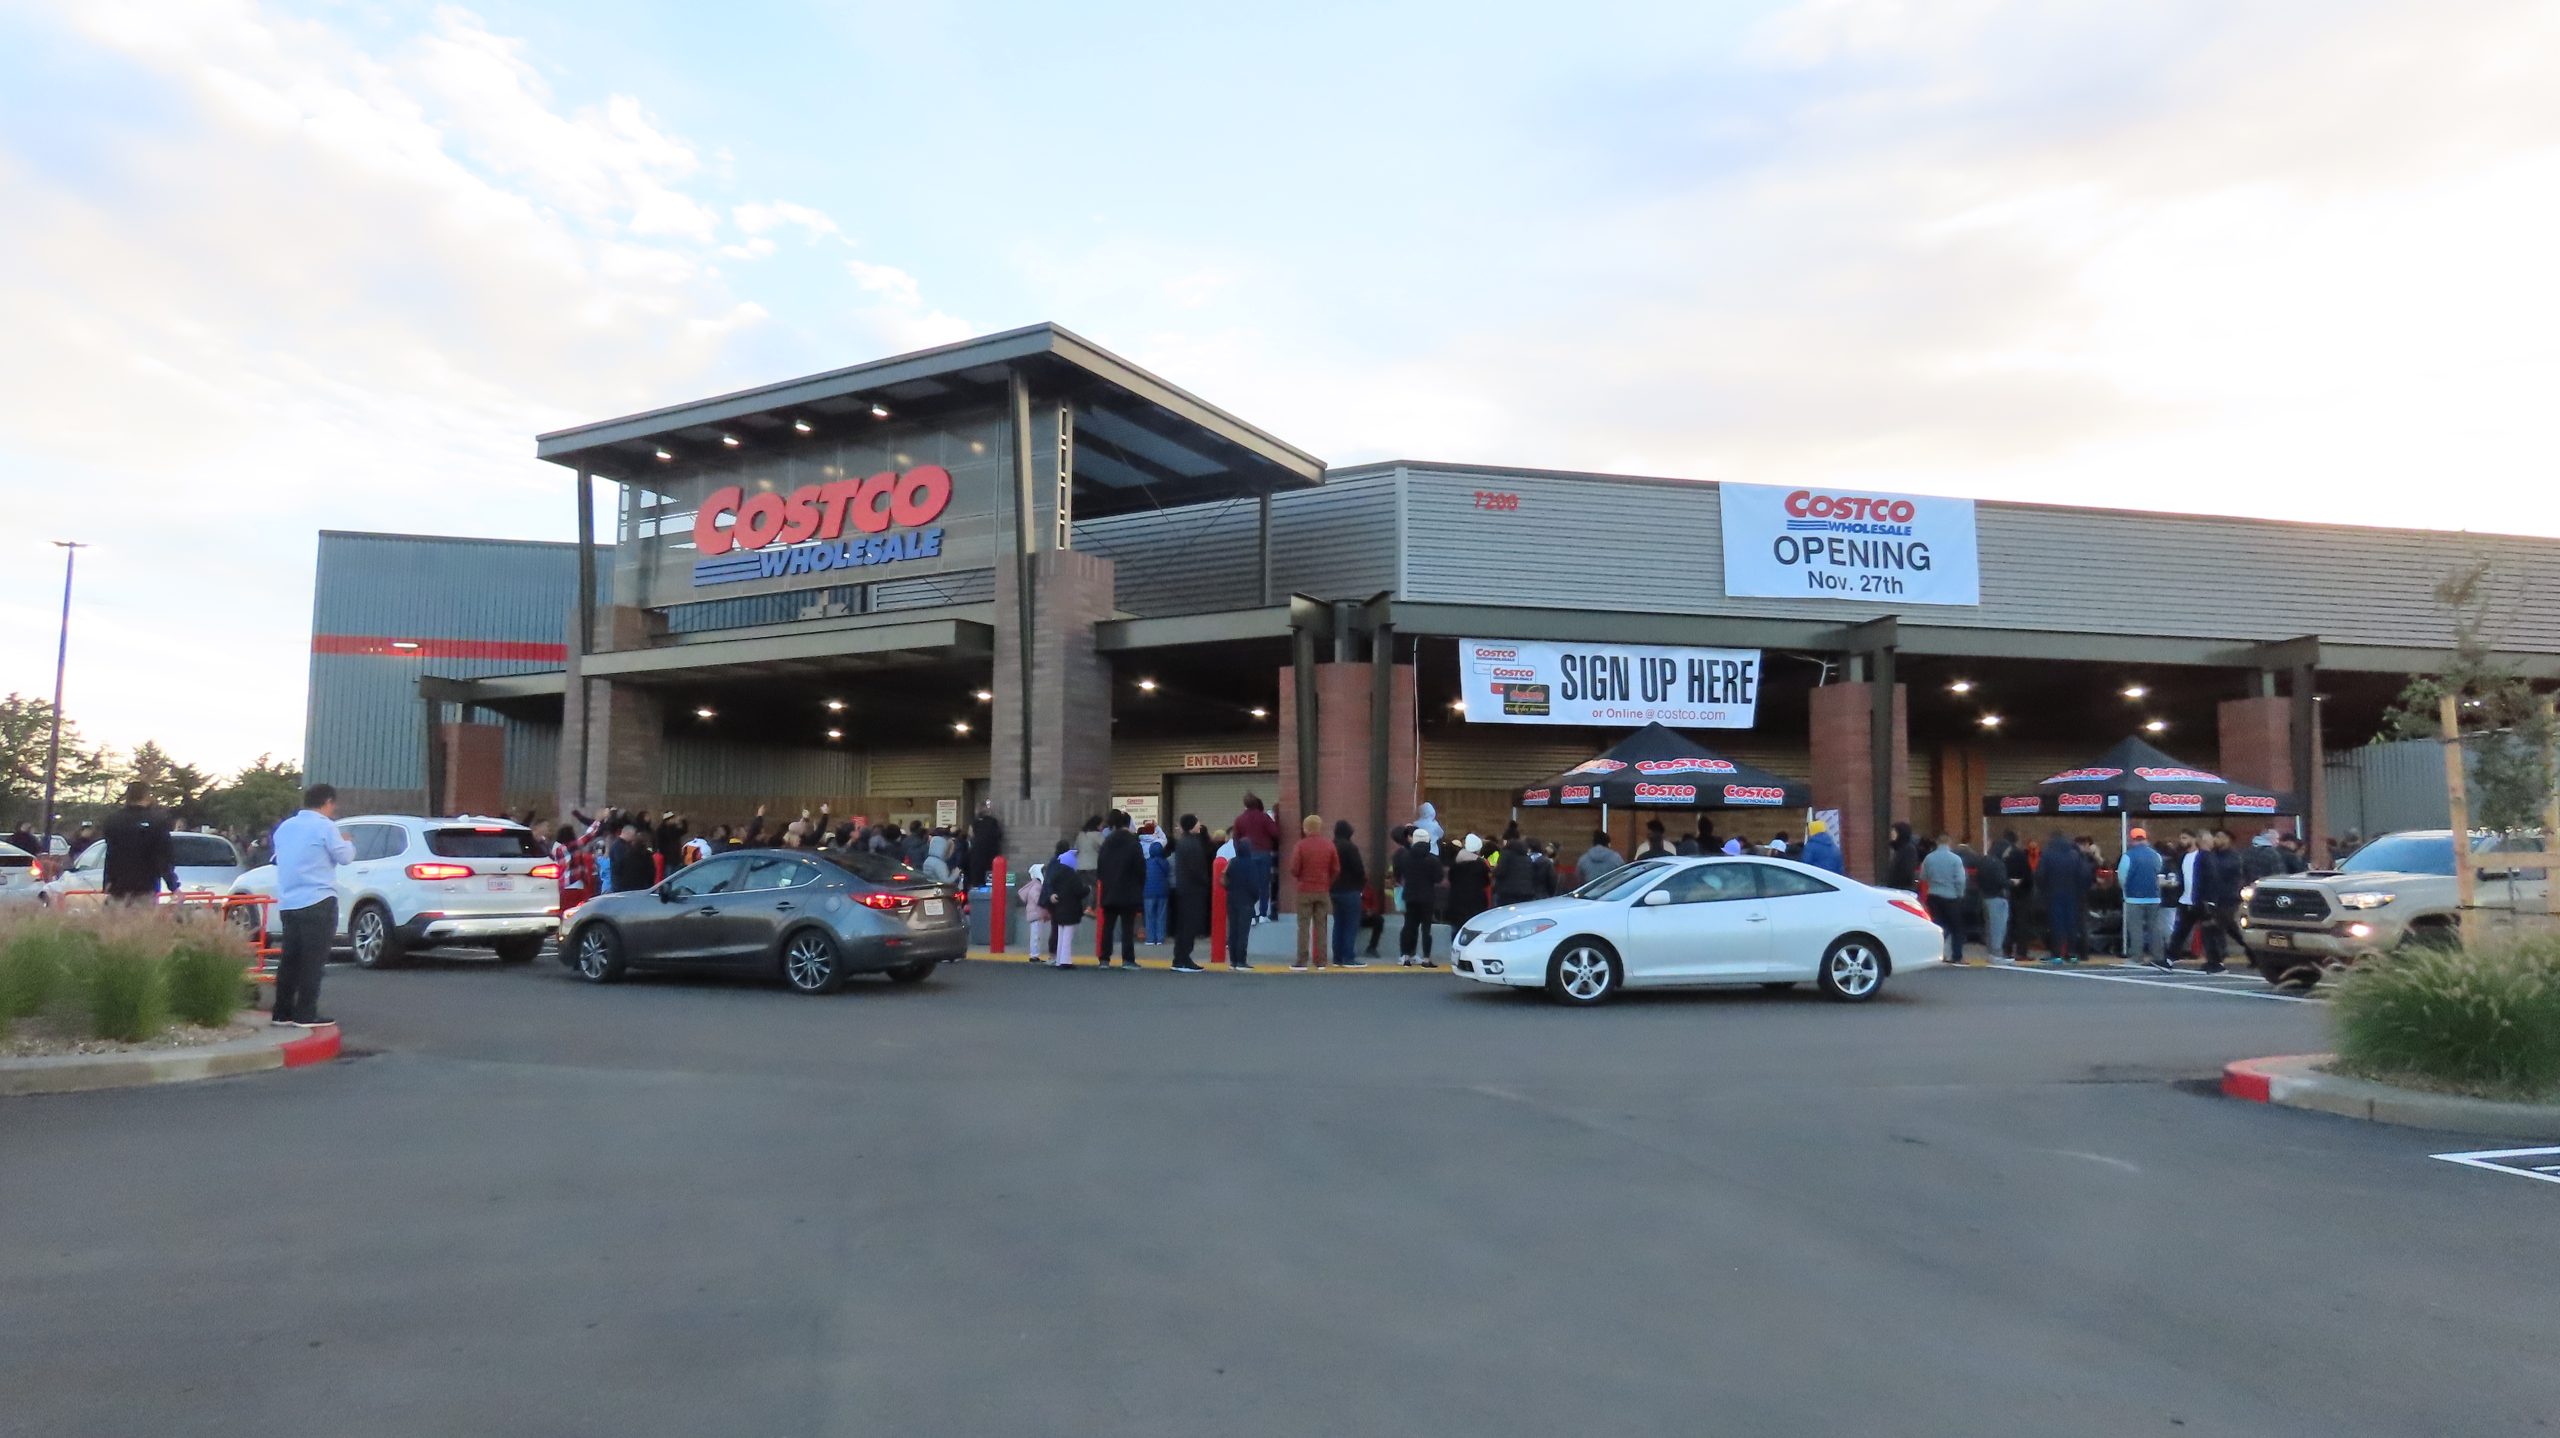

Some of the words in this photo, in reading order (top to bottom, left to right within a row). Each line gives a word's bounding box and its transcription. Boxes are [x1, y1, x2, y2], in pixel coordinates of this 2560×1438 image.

[693, 464, 953, 555] COSTCO
[1785, 490, 1915, 523] COSTCO
[1828, 521, 1912, 536] WHOLESALE
[759, 527, 944, 578] WHOLESALE
[1773, 535, 1931, 571] OPENING
[1808, 571, 1853, 591] Nov.
[1860, 574, 1904, 594] 27th
[1475, 648, 1517, 658] COSTCO
[1493, 668, 1534, 677] COSTCO
[1561, 654, 1630, 701] SIGN
[1640, 657, 1677, 702] UP
[1688, 658, 1754, 704] HERE
[1592, 709, 1604, 718] or
[1606, 708, 1643, 719] Online
[1657, 708, 1726, 720] costco.com
[1186, 753, 1257, 767] ENTRANCE
[1635, 758, 1733, 770] COSTCO
[1635, 783, 1696, 797] COSTCO
[1724, 785, 1784, 798] COSTCO
[2150, 792, 2202, 804] COSTCO
[2225, 794, 2276, 807] COSTCO
